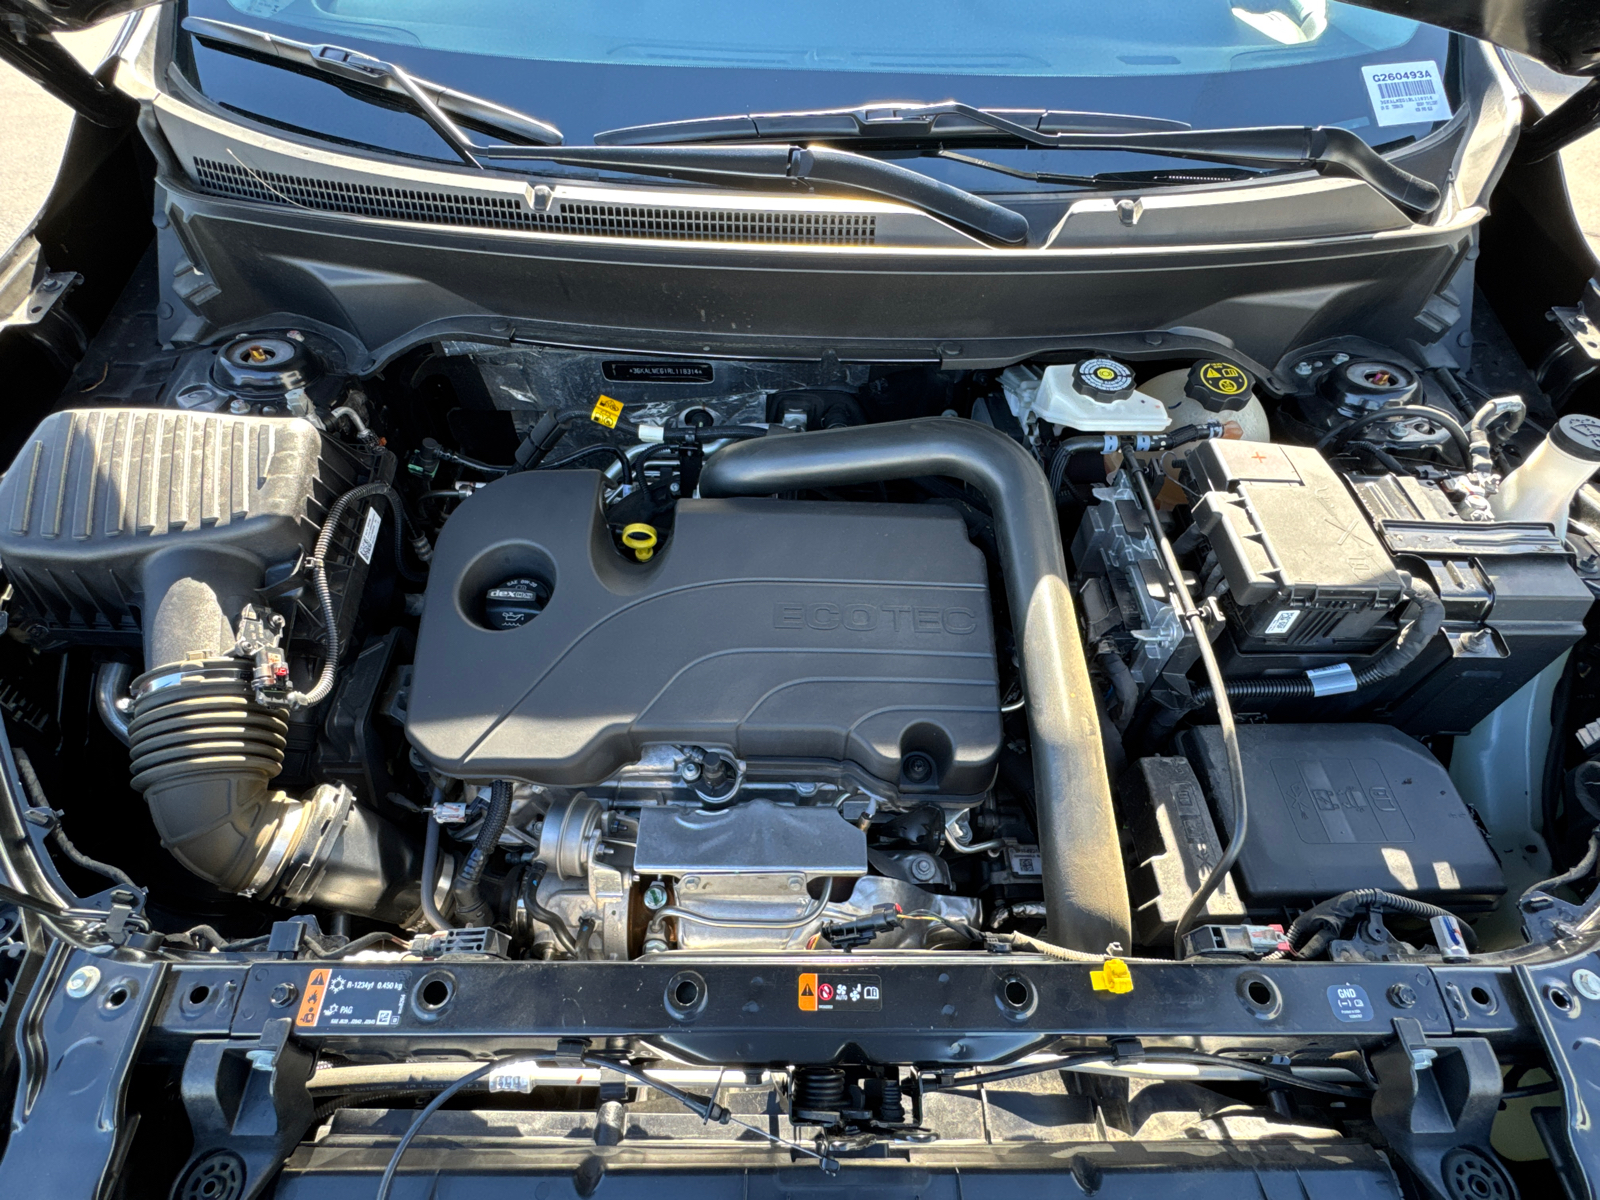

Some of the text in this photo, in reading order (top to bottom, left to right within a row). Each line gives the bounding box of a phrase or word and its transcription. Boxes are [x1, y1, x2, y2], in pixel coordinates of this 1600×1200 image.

[1372, 70, 1432, 83] G260493A
[774, 602, 978, 635] ECOTEC
[346, 981, 403, 991] R-1234yf 0.450 kg
[1337, 988, 1357, 999] GND
[340, 1006, 354, 1015] PAG
